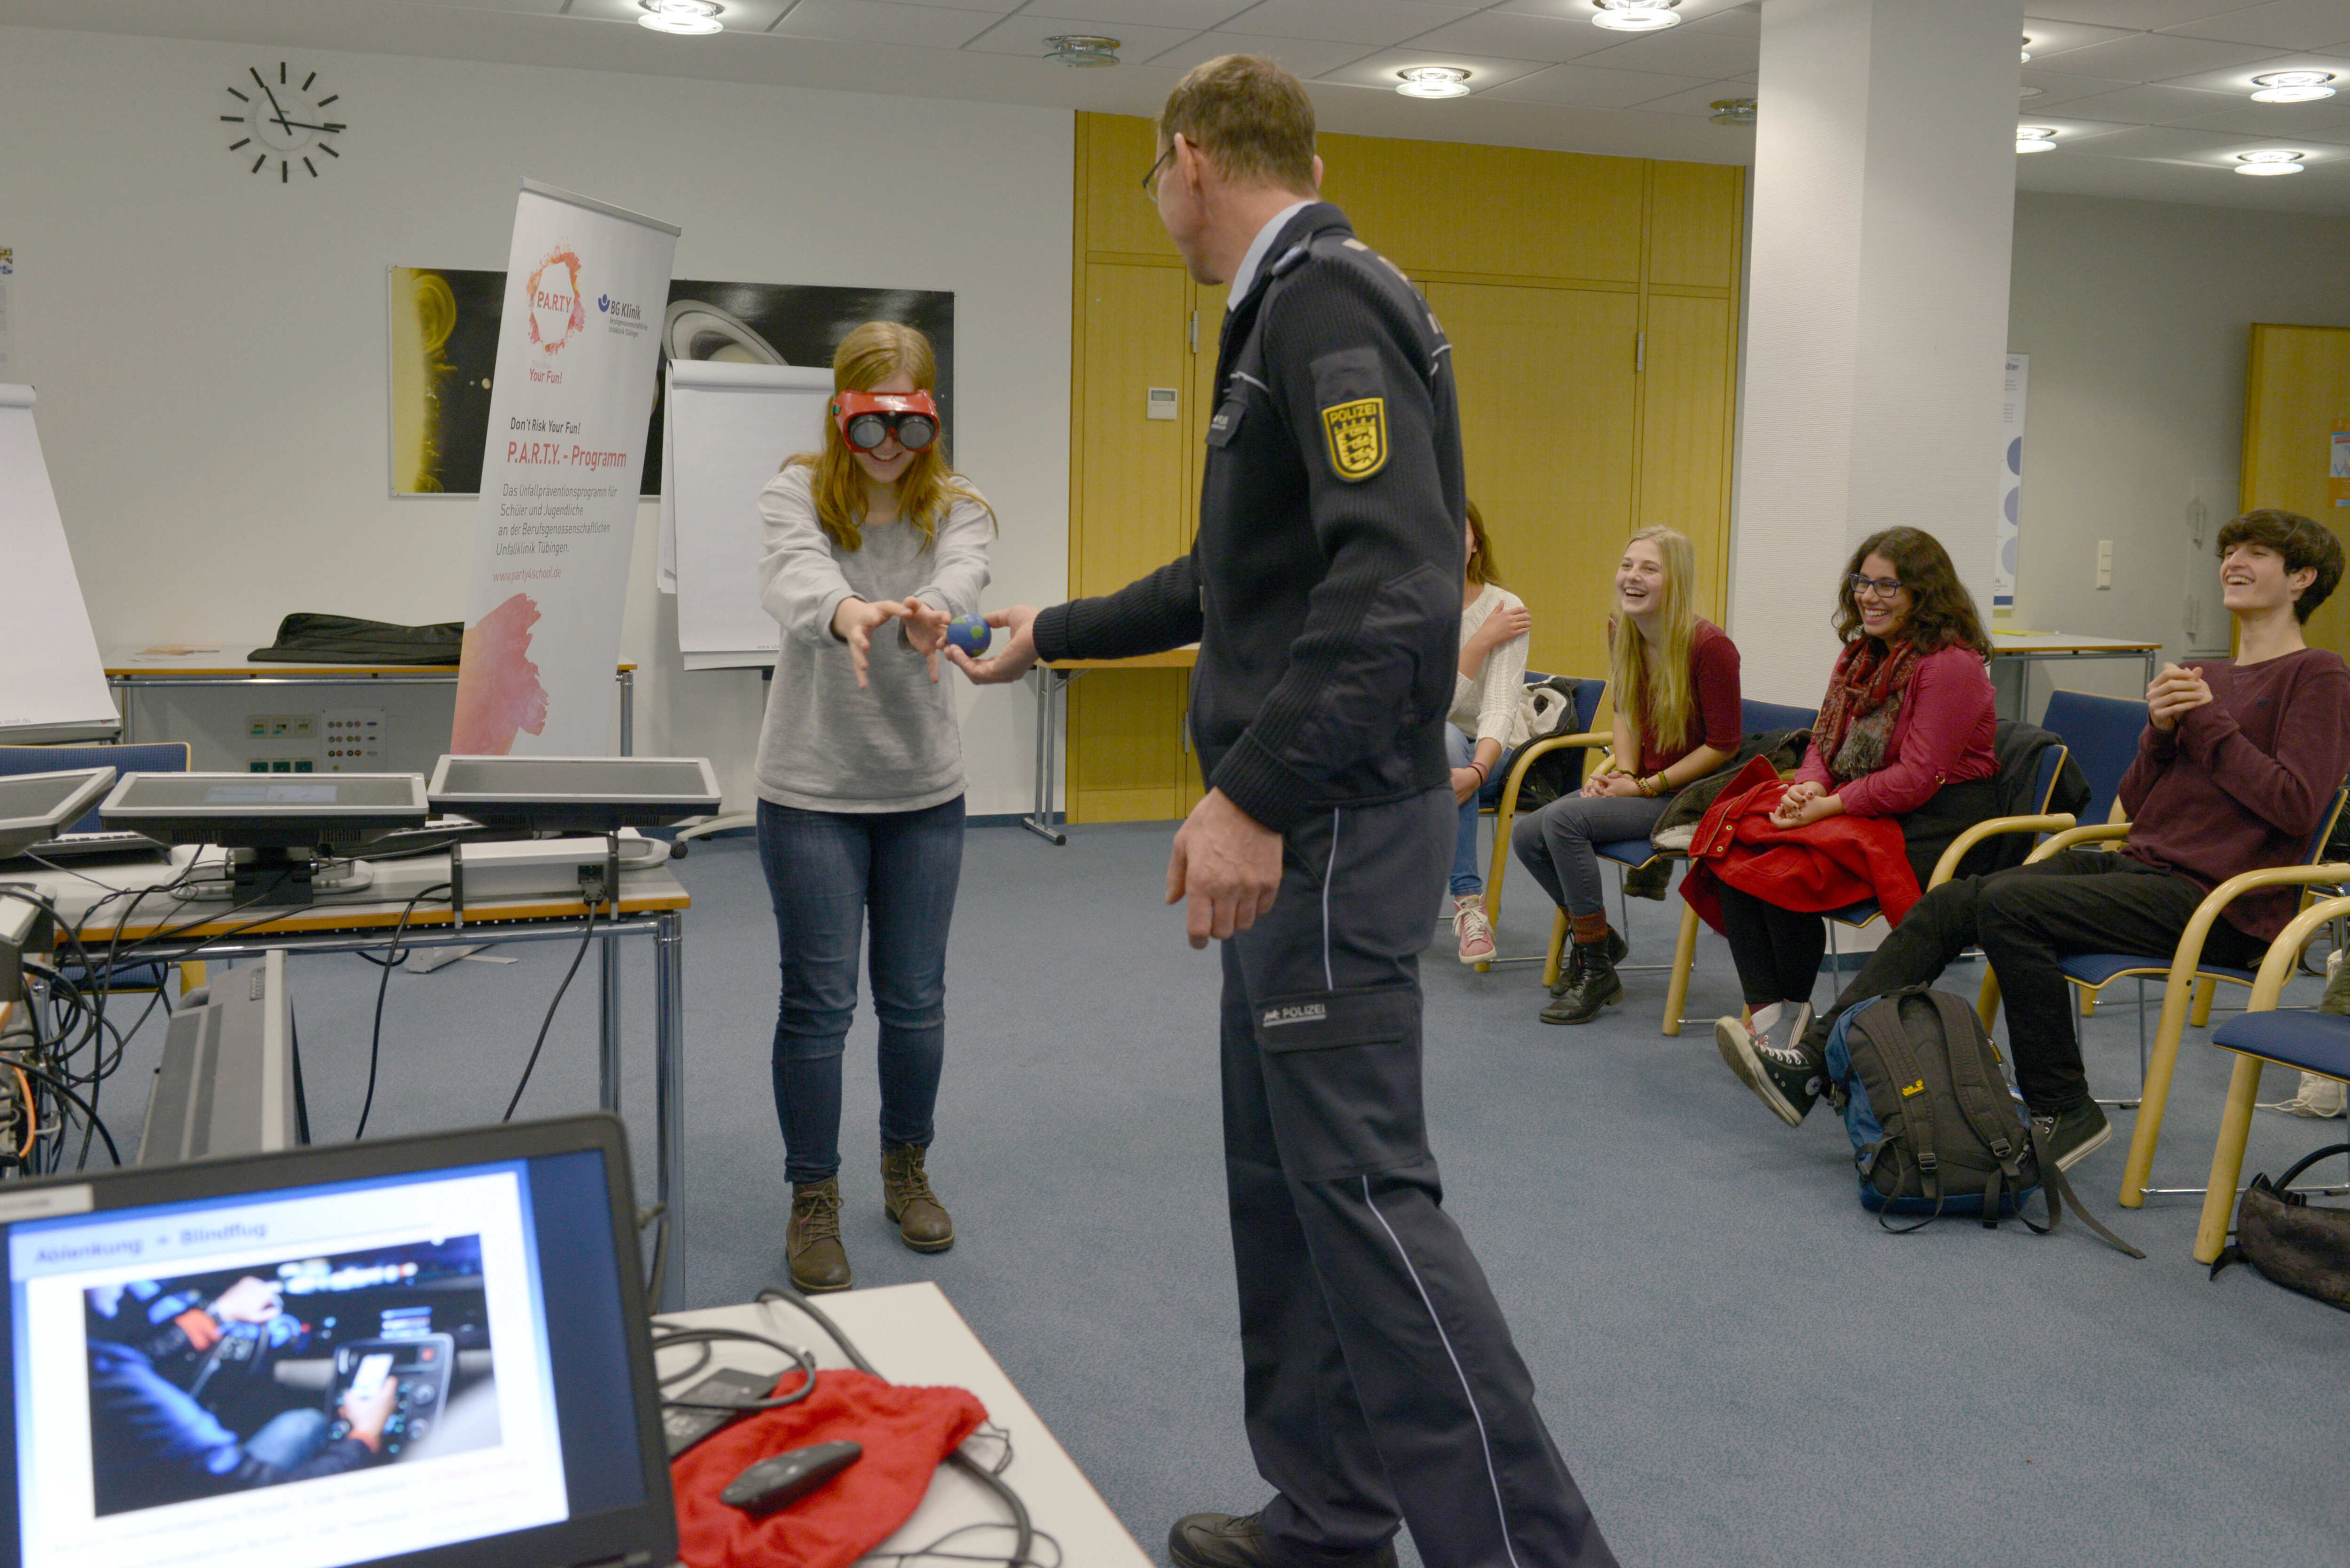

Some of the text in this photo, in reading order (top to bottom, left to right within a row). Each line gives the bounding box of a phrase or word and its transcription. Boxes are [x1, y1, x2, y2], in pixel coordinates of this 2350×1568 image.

[610, 300, 641, 320] BG Klinik
[530, 368, 563, 384] Your Fun!
[1329, 404, 1377, 425] POLIZEI
[510, 417, 580, 434] Don't Risk Your Fun!
[507, 441, 560, 465] P.A.R.T.Y.
[571, 445, 627, 472] Programm
[503, 483, 618, 500] Das Unfallpräventionsprogramm für
[500, 503, 583, 519] Schüler und Jugendliche
[498, 522, 610, 538] an der Berufsgenossenschaftlichen
[496, 541, 569, 556] Unfallklinik Tübingen.
[493, 566, 562, 583] www.party4school.de
[1282, 1004, 1325, 1019] POLIZEI
